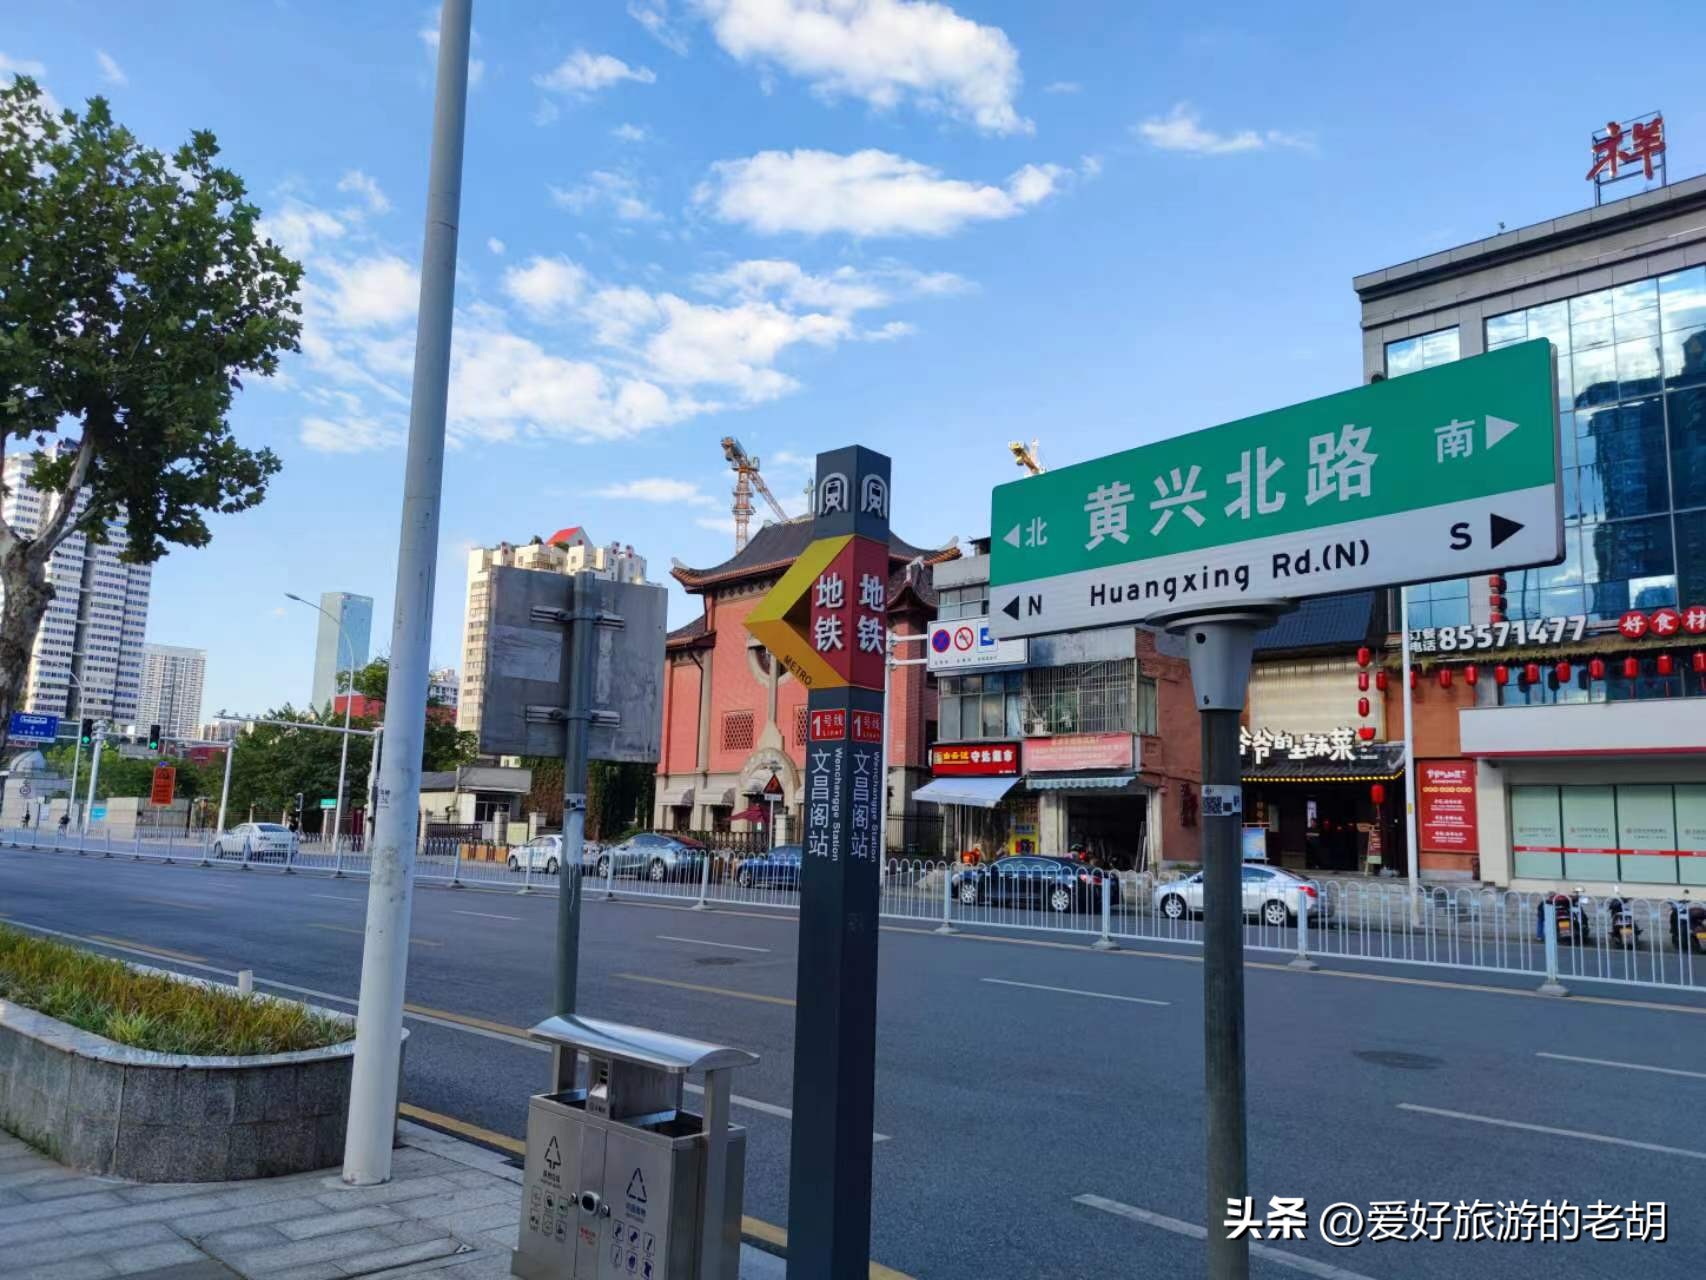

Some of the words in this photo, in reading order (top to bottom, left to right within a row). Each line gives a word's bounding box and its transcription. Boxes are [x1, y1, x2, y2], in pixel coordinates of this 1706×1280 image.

[1434, 418, 1476, 463] 南
[1083, 423, 1379, 551] 黄兴北路
[1025, 517, 1048, 547] 北
[1450, 522, 1472, 551] S
[1090, 562, 1250, 608] Huangxing
[1272, 539, 1370, 580] Rd.(N)
[815, 572, 844, 652] 地铁
[857, 573, 885, 655] 地铁
[1028, 594, 1043, 617] N
[1438, 615, 1586, 651] 85571477
[783, 654, 812, 686] METRO
[808, 748, 832, 858] 文昌阁站
[832, 747, 843, 818] Wenchangge
[851, 750, 870, 859] 文昌阁站
[832, 822, 841, 862] Station
